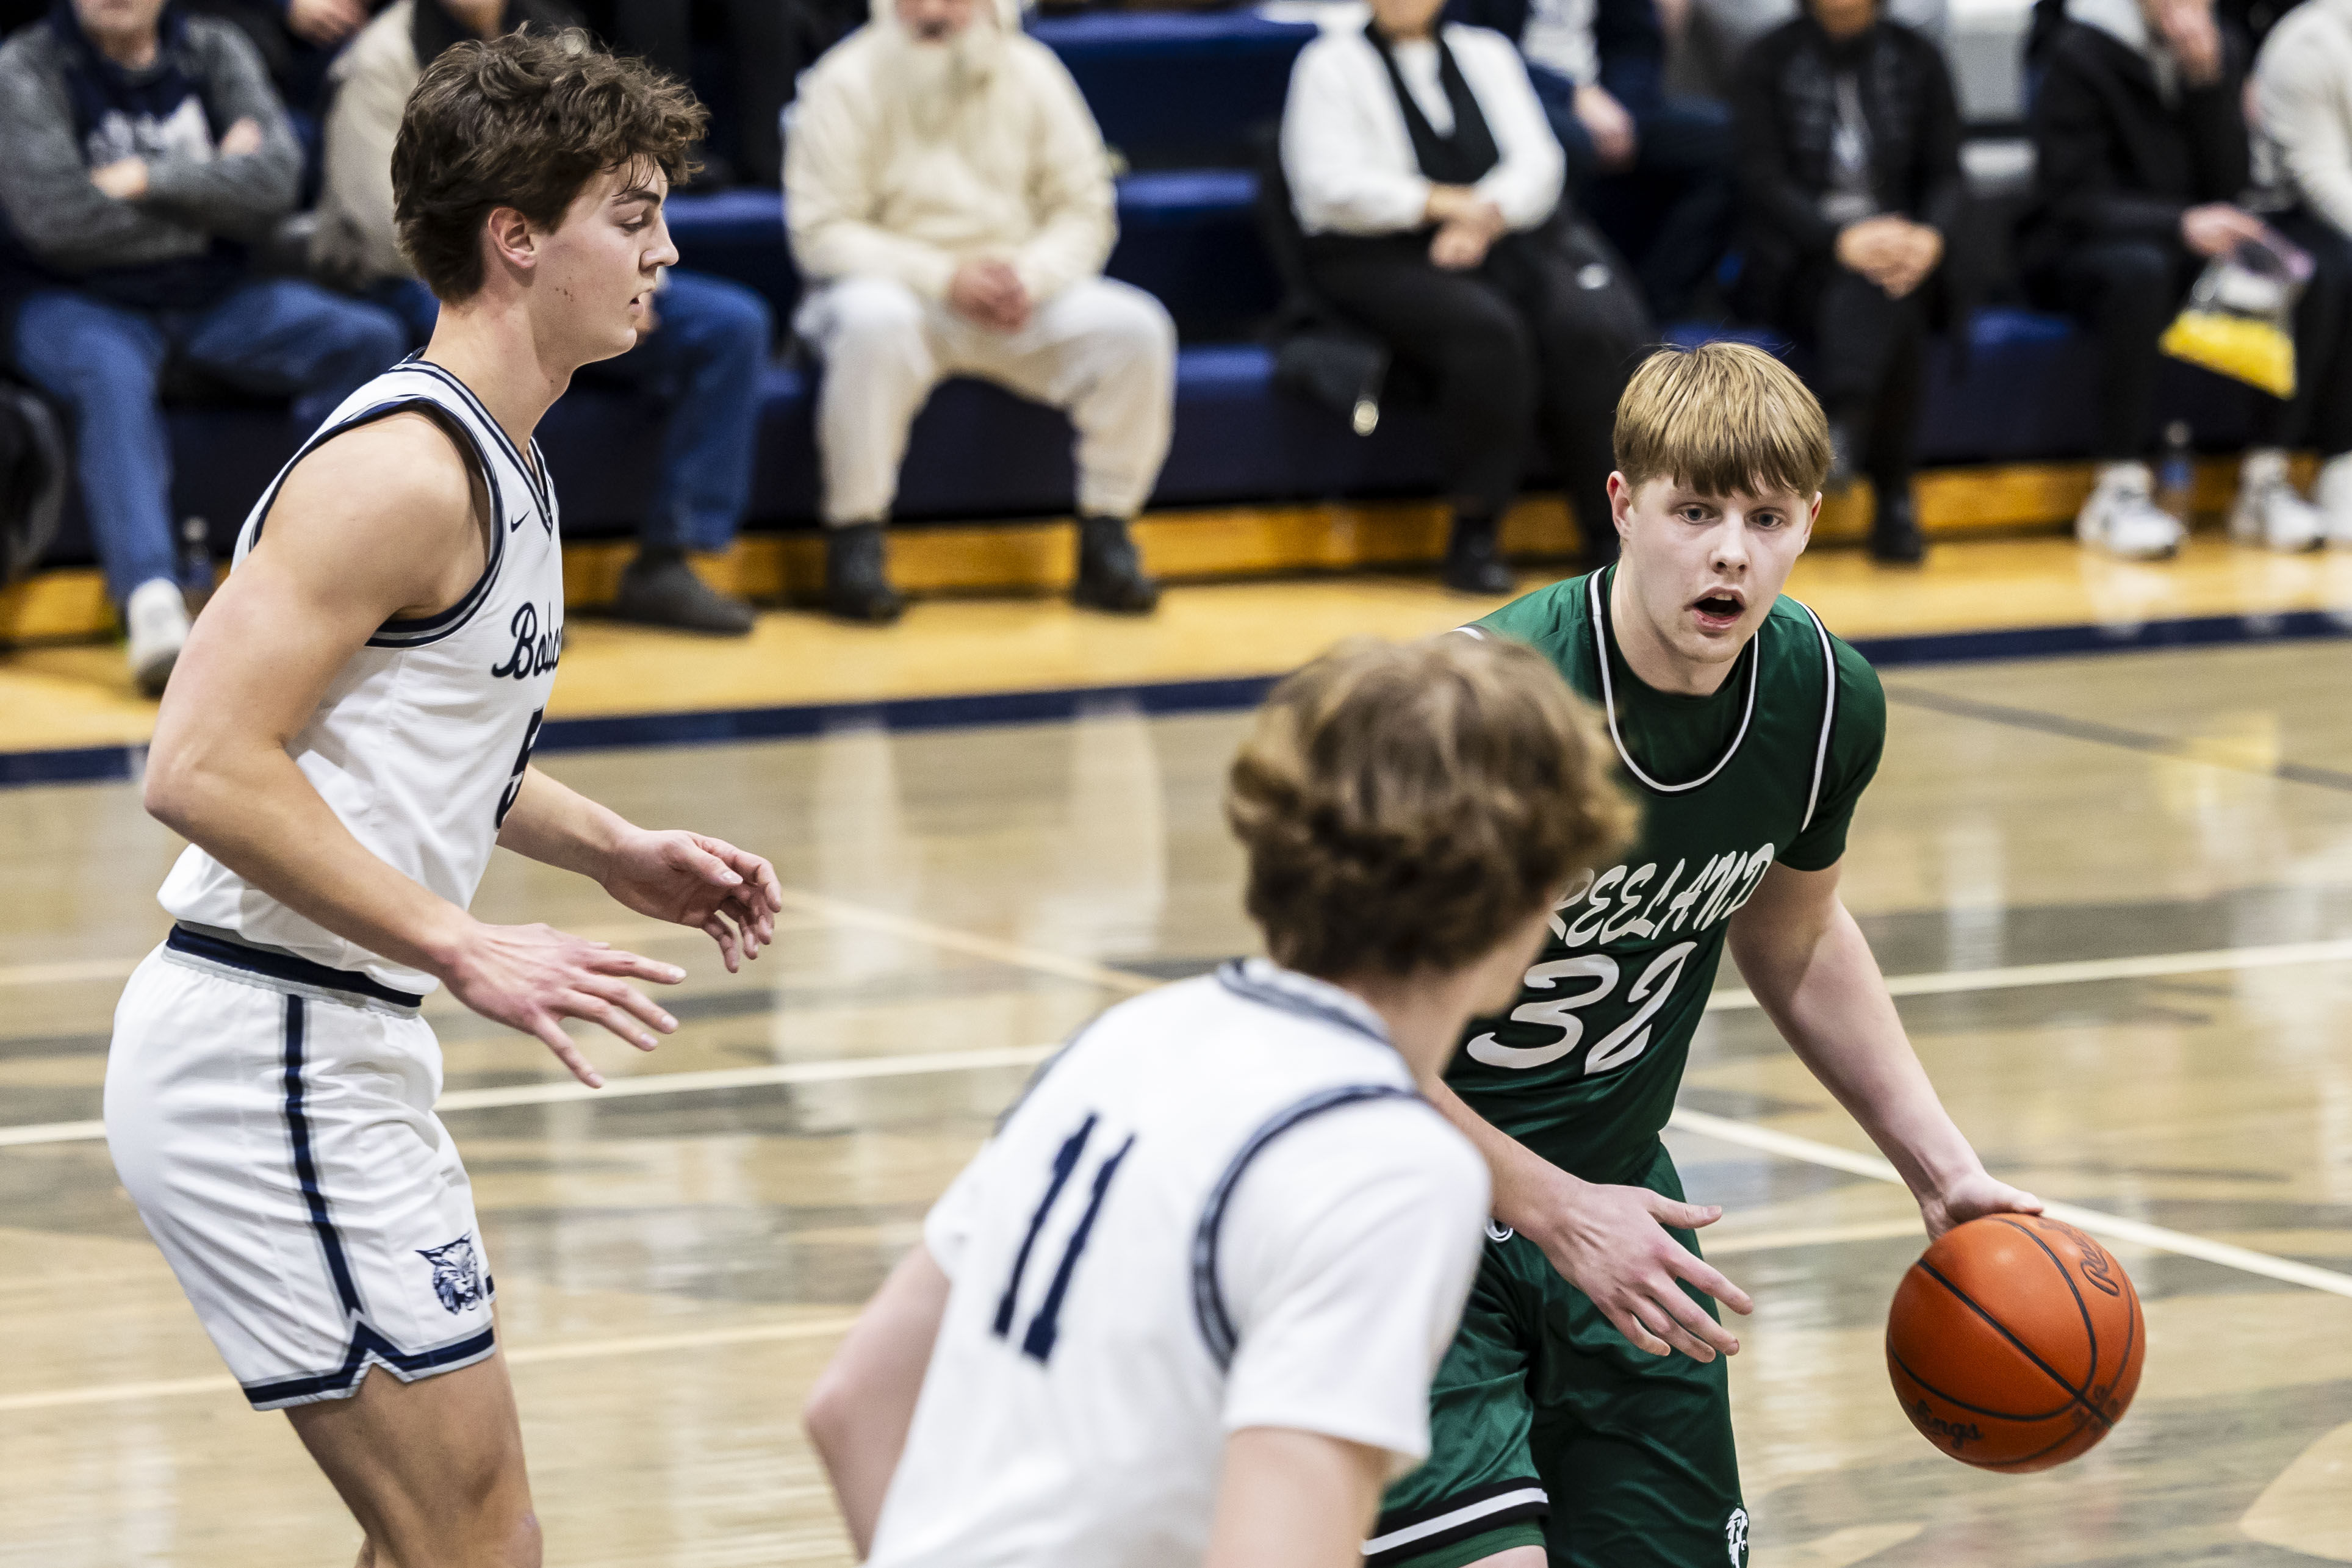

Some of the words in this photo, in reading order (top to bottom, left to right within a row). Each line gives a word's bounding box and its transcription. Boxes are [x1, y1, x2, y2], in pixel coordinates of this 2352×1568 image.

[1548, 843, 1774, 948] REELAND
[1466, 941, 1697, 1076] 32
[993, 1112, 1138, 1367] 11
